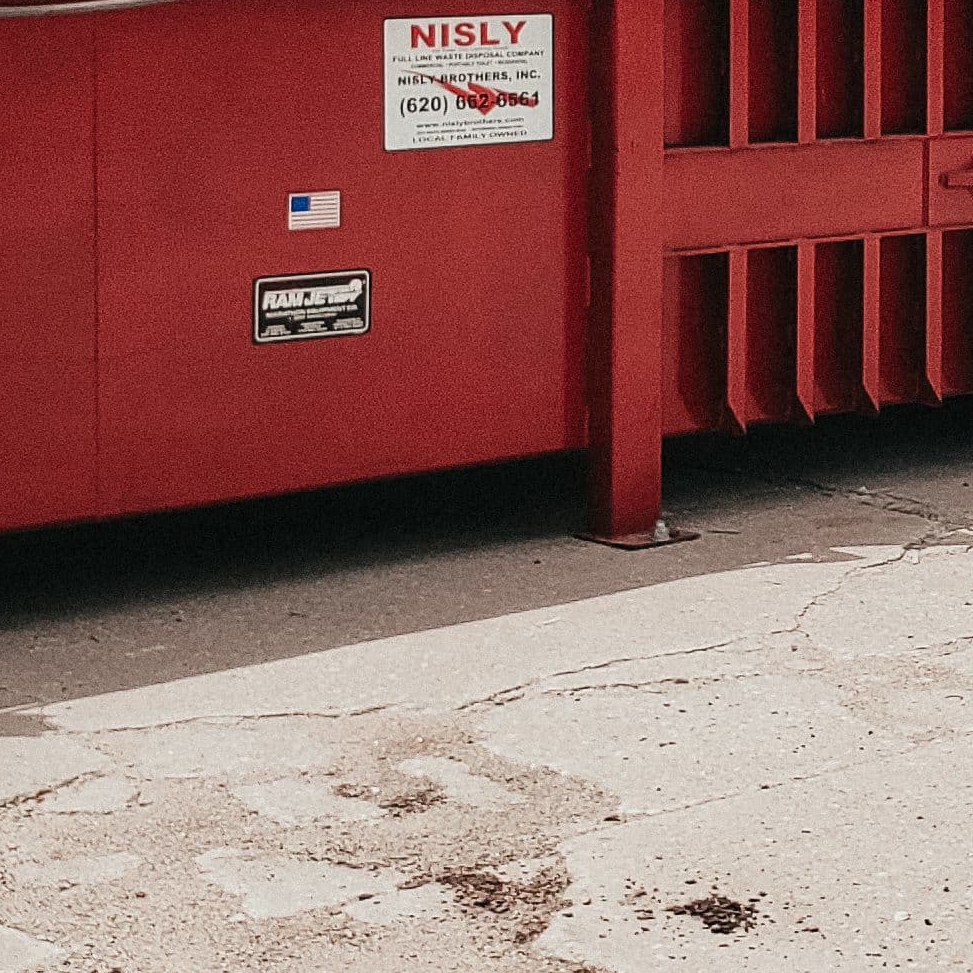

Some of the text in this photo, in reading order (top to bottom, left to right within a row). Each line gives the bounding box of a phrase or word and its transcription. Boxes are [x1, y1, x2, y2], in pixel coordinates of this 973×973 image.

[410, 20, 527, 49] NISLY
[435, 52, 462, 61] WASTE
[506, 50, 544, 58] COMPANY
[398, 69, 541, 86] NISLY BROTHERS, INC.
[400, 95, 448, 118] (620)
